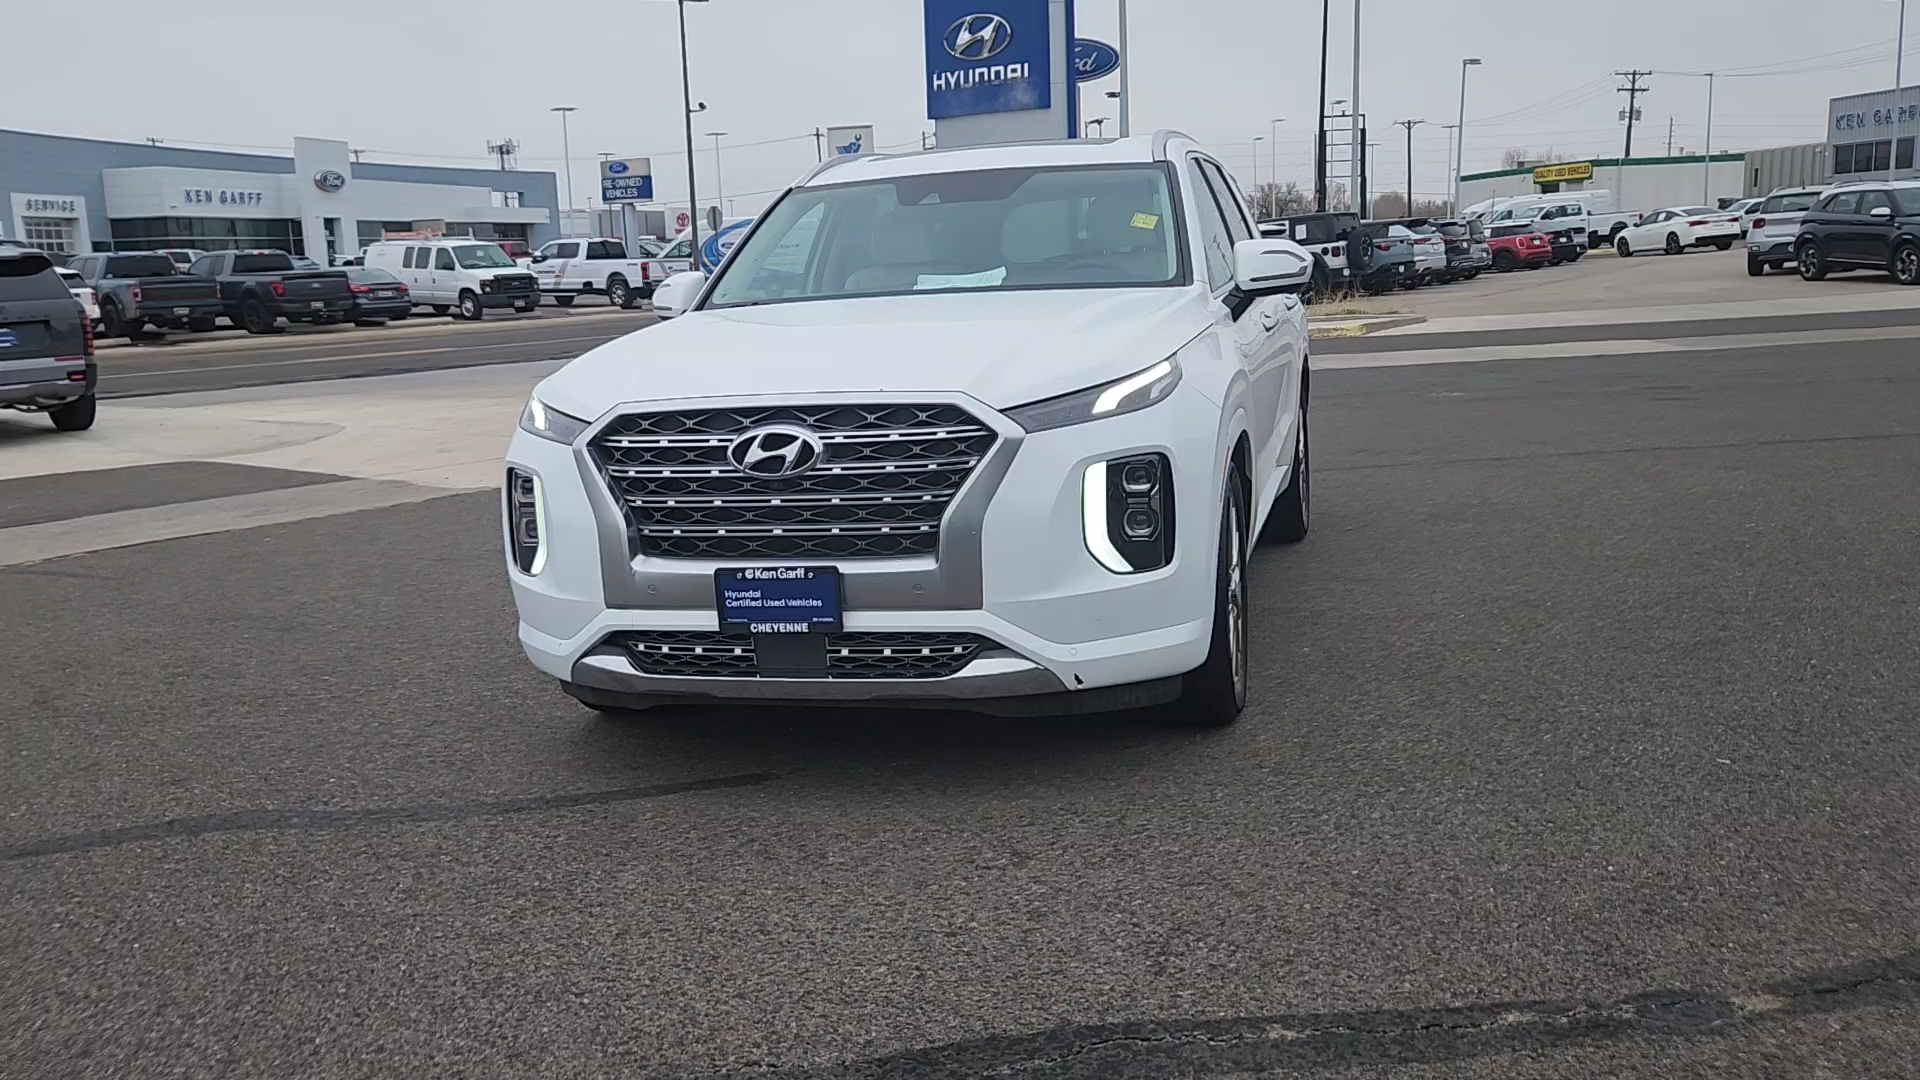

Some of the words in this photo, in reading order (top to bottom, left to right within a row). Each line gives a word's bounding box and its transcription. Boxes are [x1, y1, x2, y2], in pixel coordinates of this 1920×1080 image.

[933, 62, 1029, 92] HYUNDAI
[1836, 111, 1864, 129] KEN
[1535, 168, 1553, 179] QUALITY
[1554, 167, 1567, 177] USED
[1567, 164, 1590, 176] VEHICLES
[602, 177, 643, 189] PRE-OWNED
[184, 188, 213, 204] KEN
[218, 191, 264, 206] GARFF
[605, 188, 639, 198] VEHICLES
[25, 197, 76, 214] SERVICE
[755, 568, 777, 579] Ken
[777, 568, 805, 579] Garff
[724, 590, 761, 599] Hyundai
[725, 599, 762, 607] Certified
[763, 599, 785, 607] Used
[786, 598, 823, 607] Vehicles
[750, 622, 809, 633] CHEYENNE
